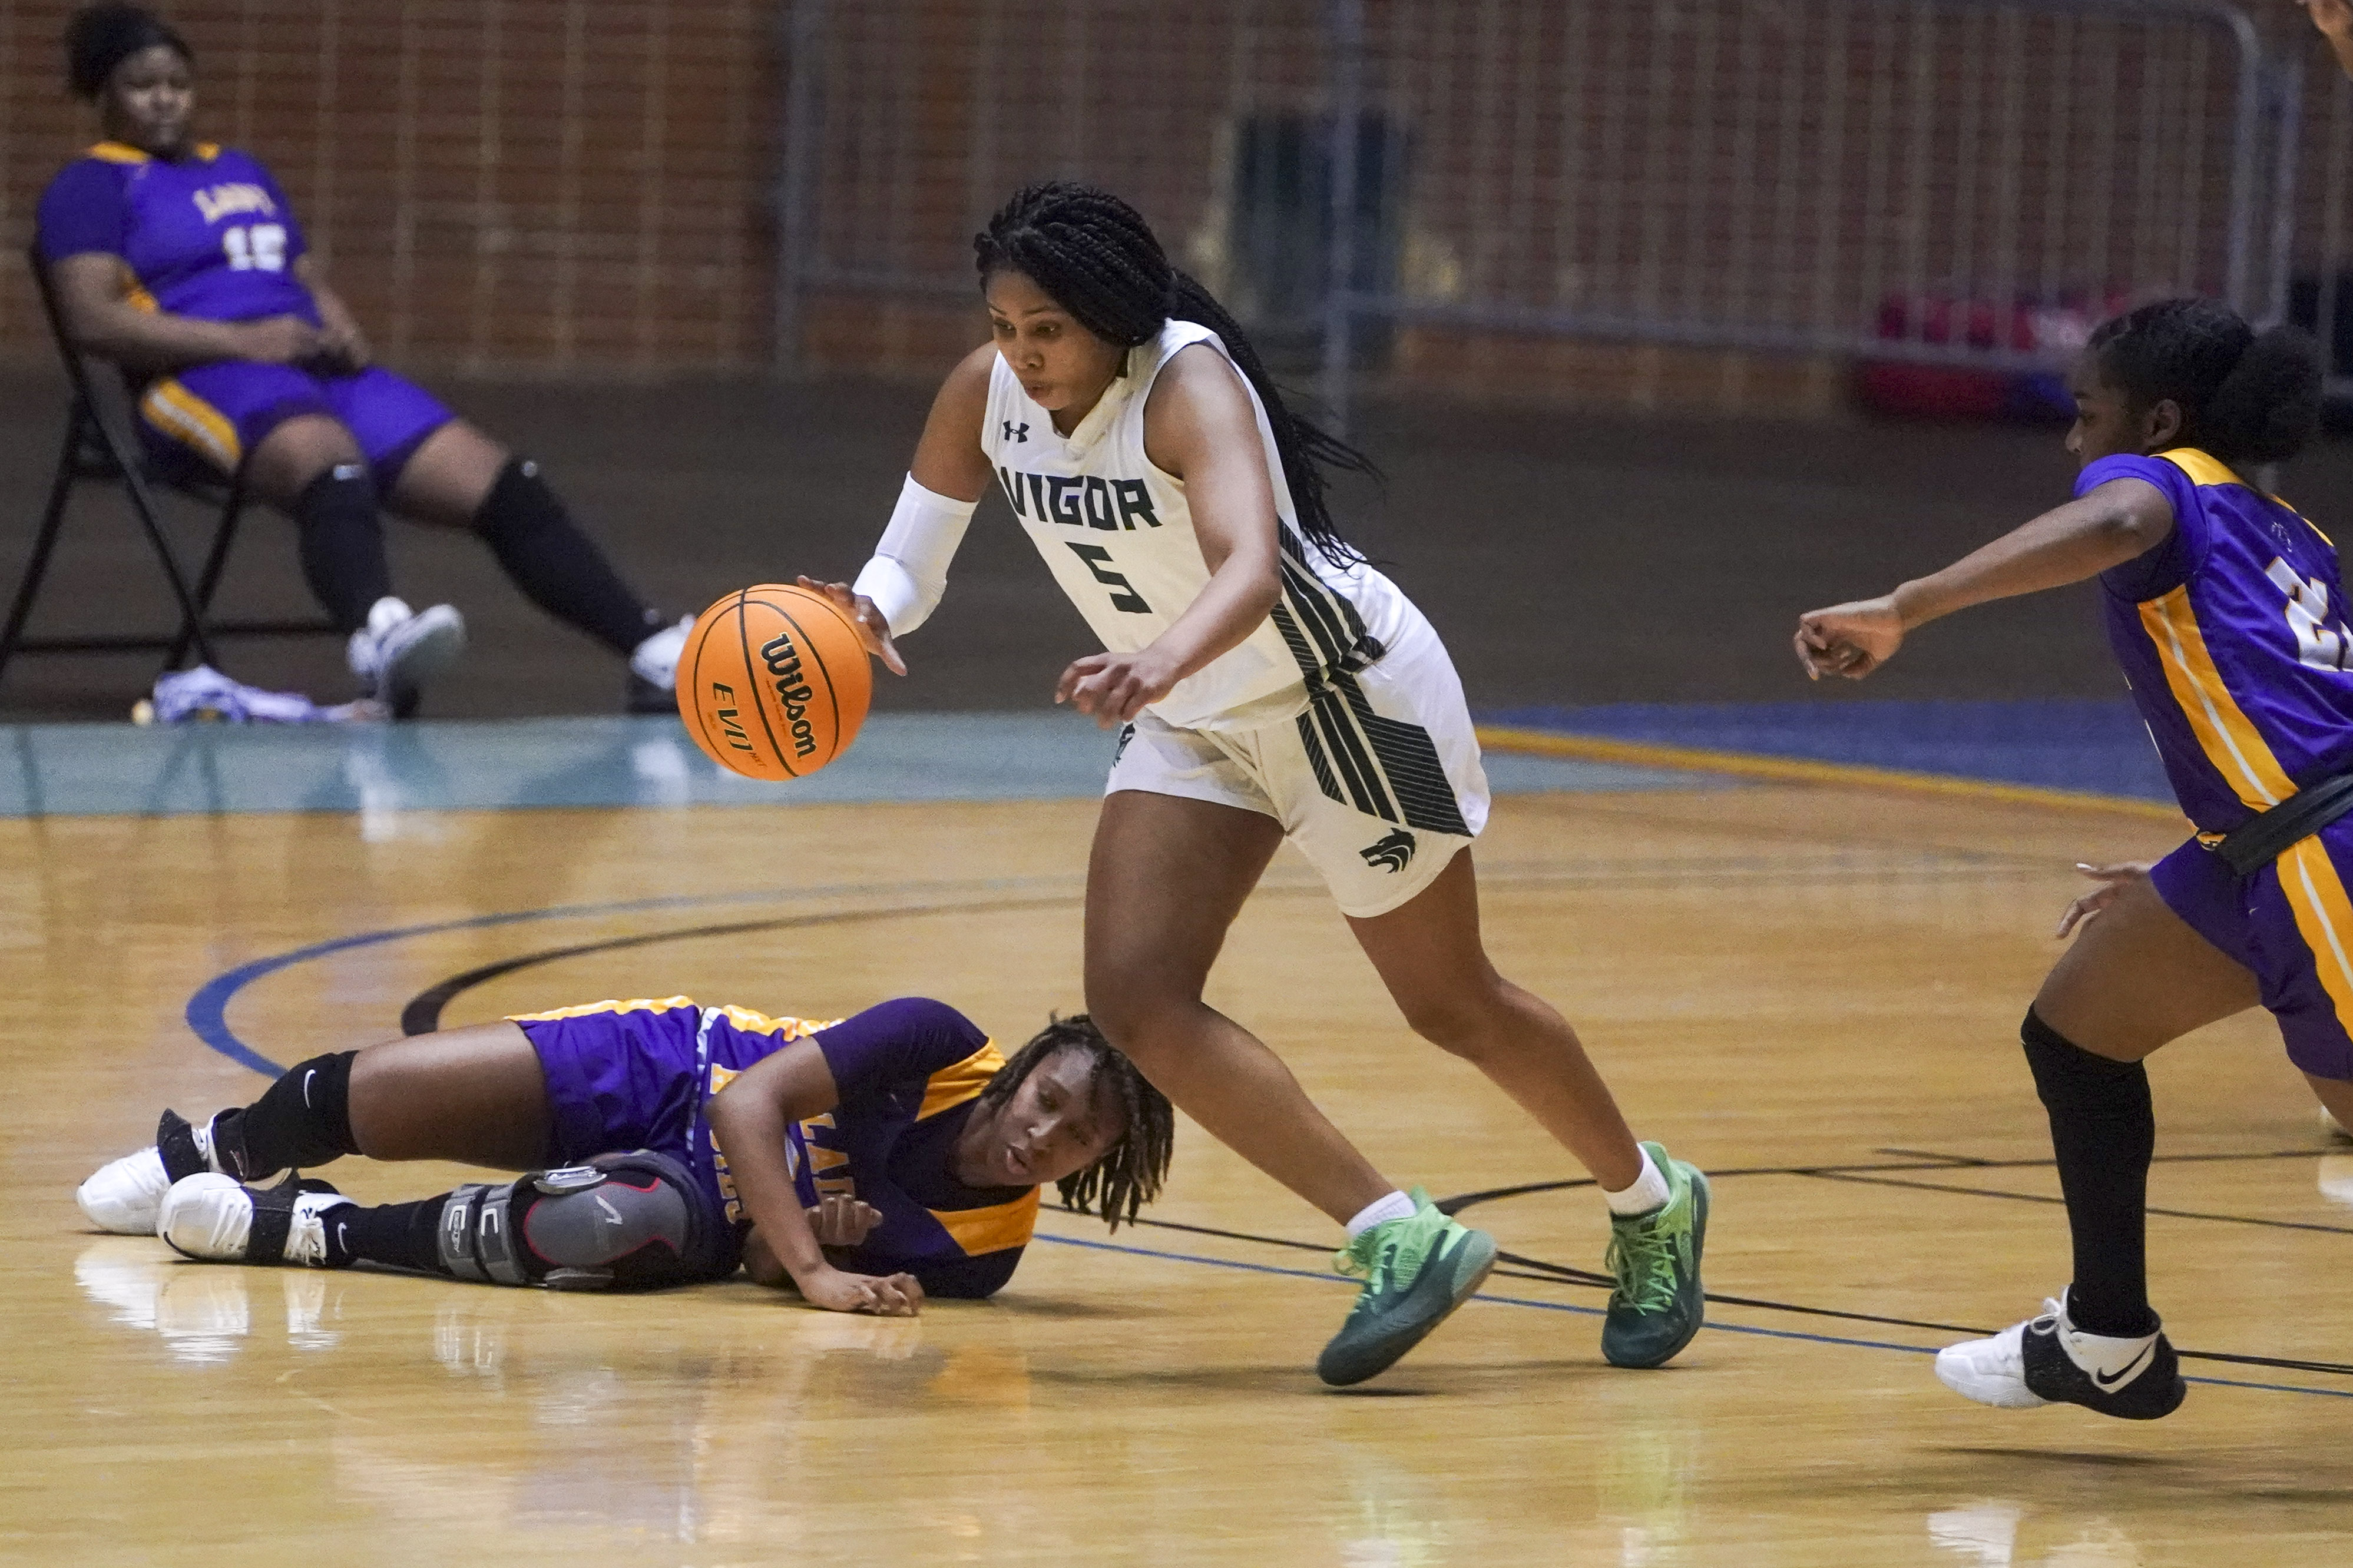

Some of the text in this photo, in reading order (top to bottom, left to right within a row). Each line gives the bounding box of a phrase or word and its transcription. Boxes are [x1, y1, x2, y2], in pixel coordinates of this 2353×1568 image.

[1001, 466, 1163, 531] VIGOR
[1064, 542, 1153, 614] 5
[760, 632, 817, 758] Wilson
